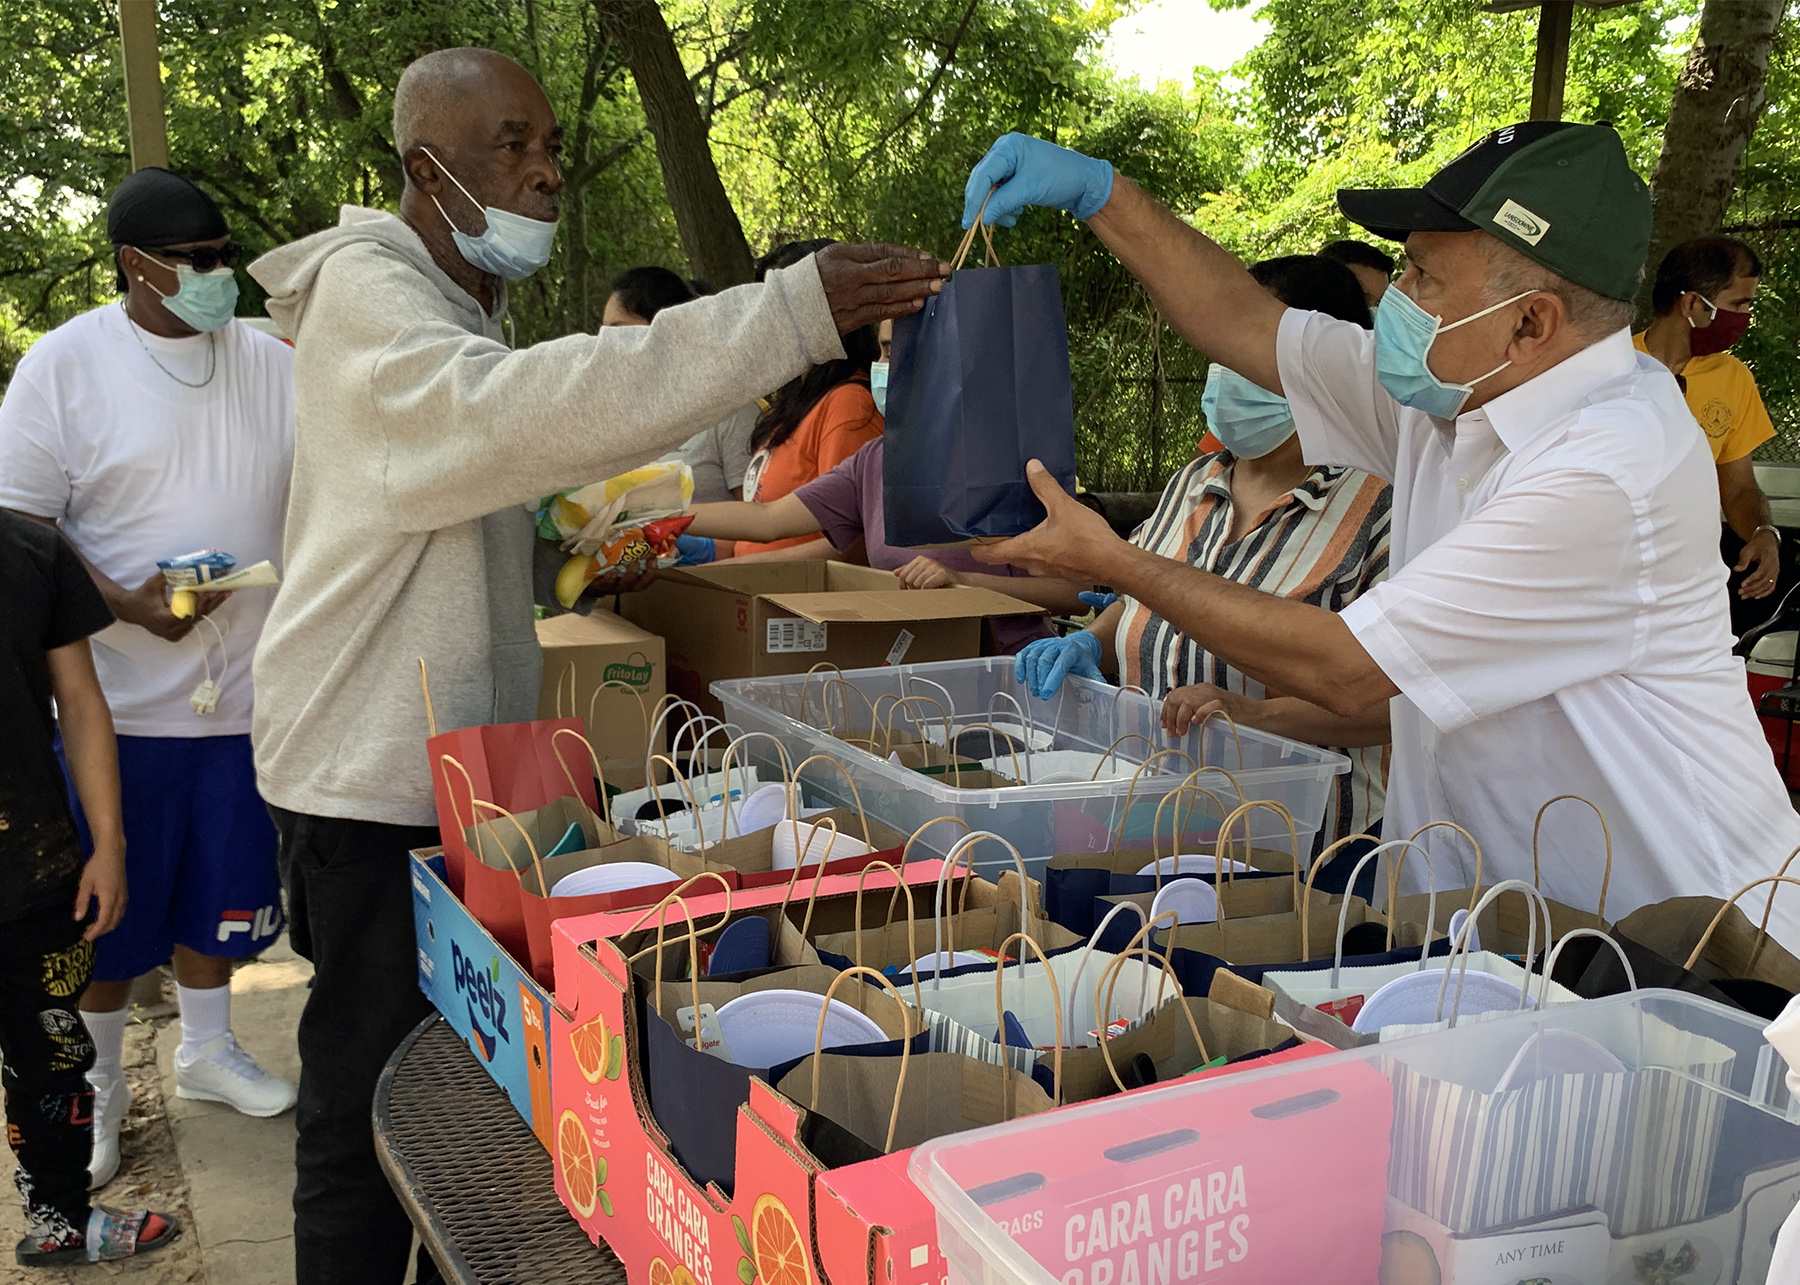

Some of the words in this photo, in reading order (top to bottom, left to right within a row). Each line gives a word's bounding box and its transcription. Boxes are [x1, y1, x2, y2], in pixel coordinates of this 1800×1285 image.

[1498, 126, 1515, 145] ND
[1503, 211, 1535, 232] LANSDOWNE
[451, 938, 510, 1045] peelz
[693, 1040, 720, 1050] Clgate
[646, 1151, 677, 1215] CARA
[677, 1187, 711, 1255] CARA
[1065, 1194, 1154, 1262] CARA
[1164, 1165, 1247, 1230] CARA
[646, 1186, 713, 1285] ORANGES
[1495, 1247, 1526, 1266] ANY
[1530, 1240, 1565, 1258] TIME
